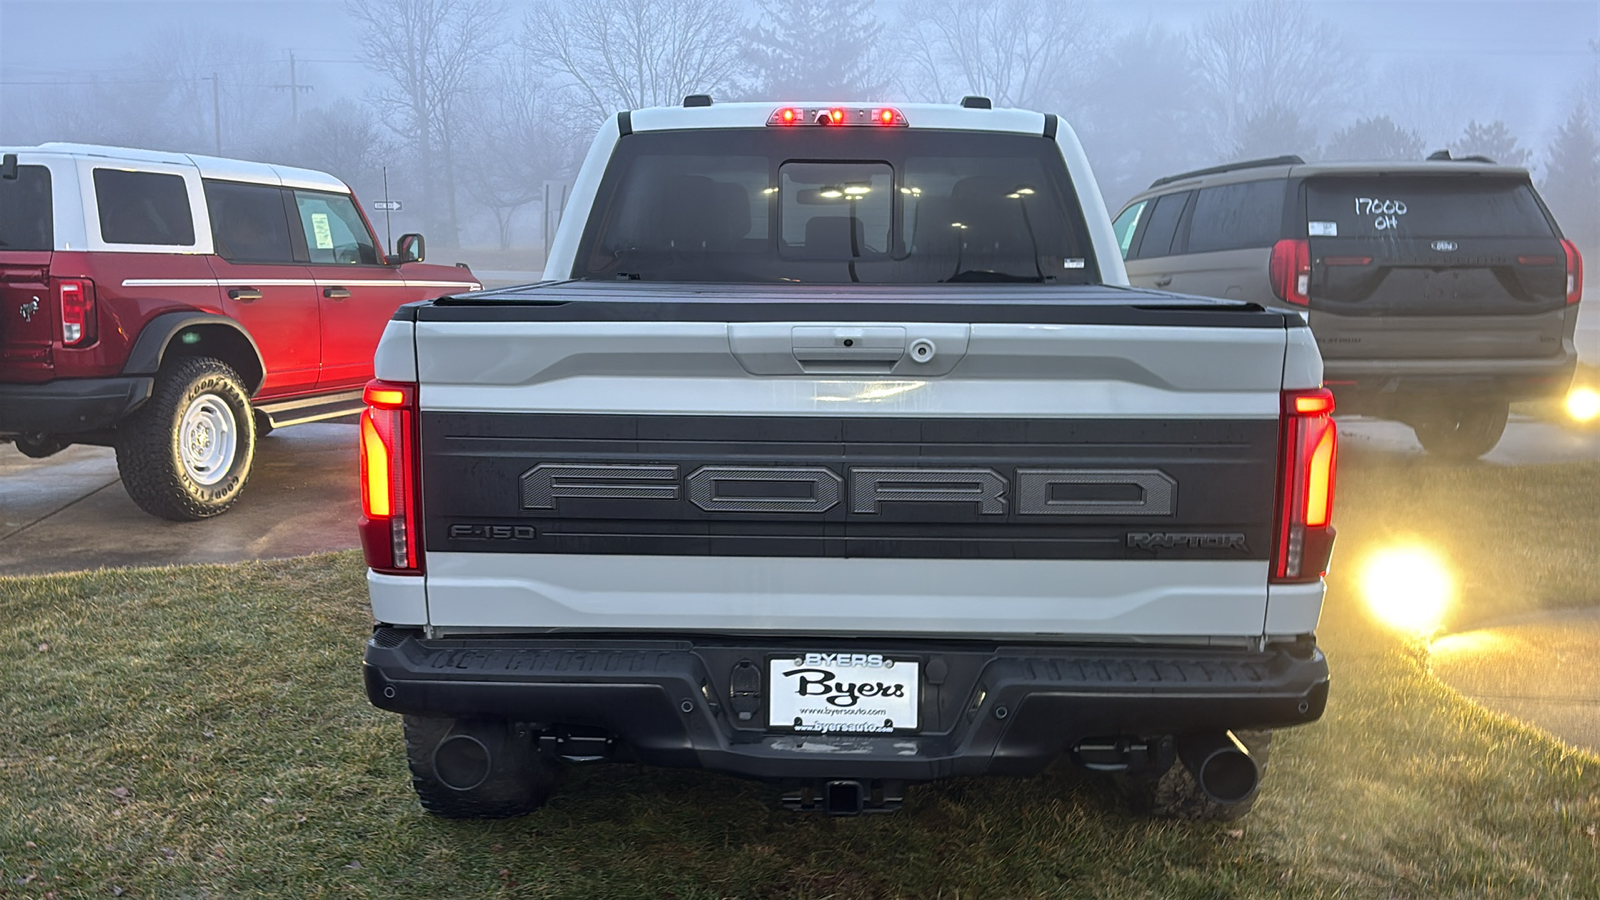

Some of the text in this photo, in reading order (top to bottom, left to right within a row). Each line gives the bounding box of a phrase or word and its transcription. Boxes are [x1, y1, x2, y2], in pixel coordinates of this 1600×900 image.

[1355, 197, 1407, 215] 17000
[520, 464, 1178, 516] FORD
[449, 524, 536, 540] F-150
[1126, 532, 1250, 553] RAPTOR
[805, 652, 884, 668] BYERS
[782, 668, 905, 708] Byers
[799, 706, 887, 716] www.byersauto.com
[794, 720, 894, 734] www.byersauto.com
